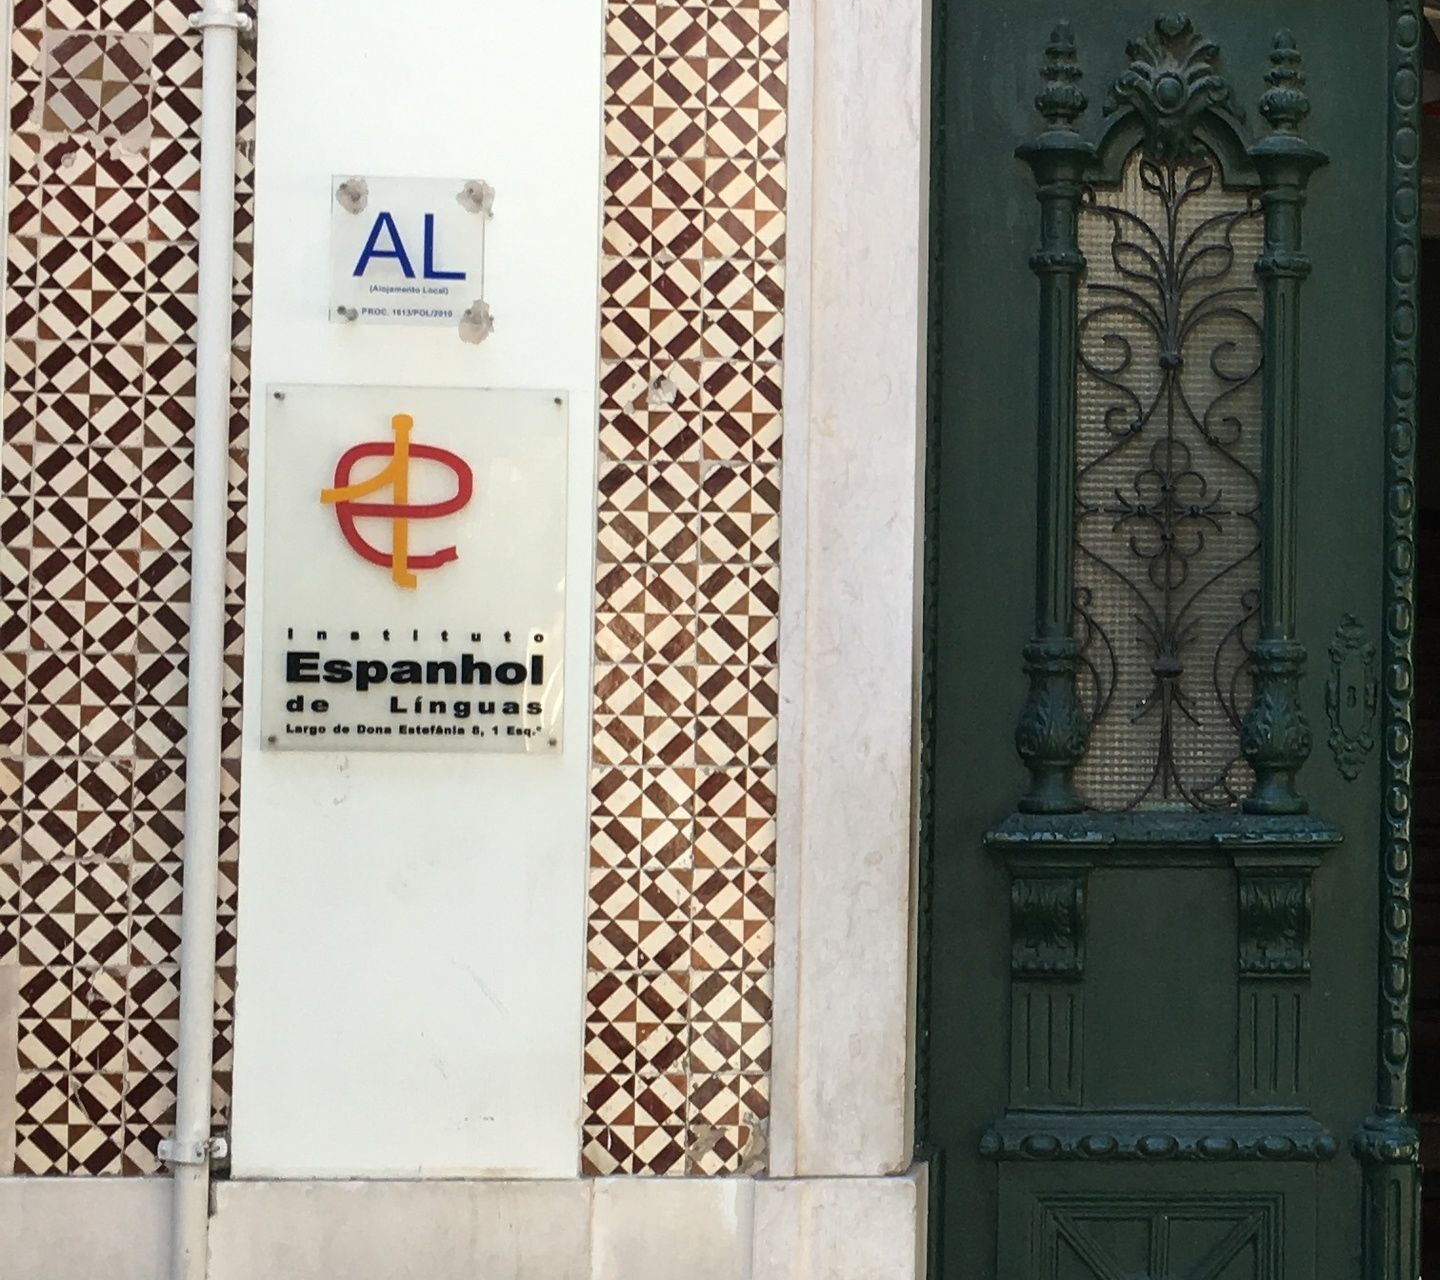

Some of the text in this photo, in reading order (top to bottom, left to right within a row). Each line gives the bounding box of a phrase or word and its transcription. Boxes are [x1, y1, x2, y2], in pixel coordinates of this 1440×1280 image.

[352, 211, 467, 281] AL
[287, 627, 544, 644] Instituto
[286, 651, 543, 692] Espanhol
[285, 694, 542, 719] de Línguas
[285, 723, 327, 737] Largo
[332, 723, 350, 735] de
[356, 724, 392, 735] Dona
